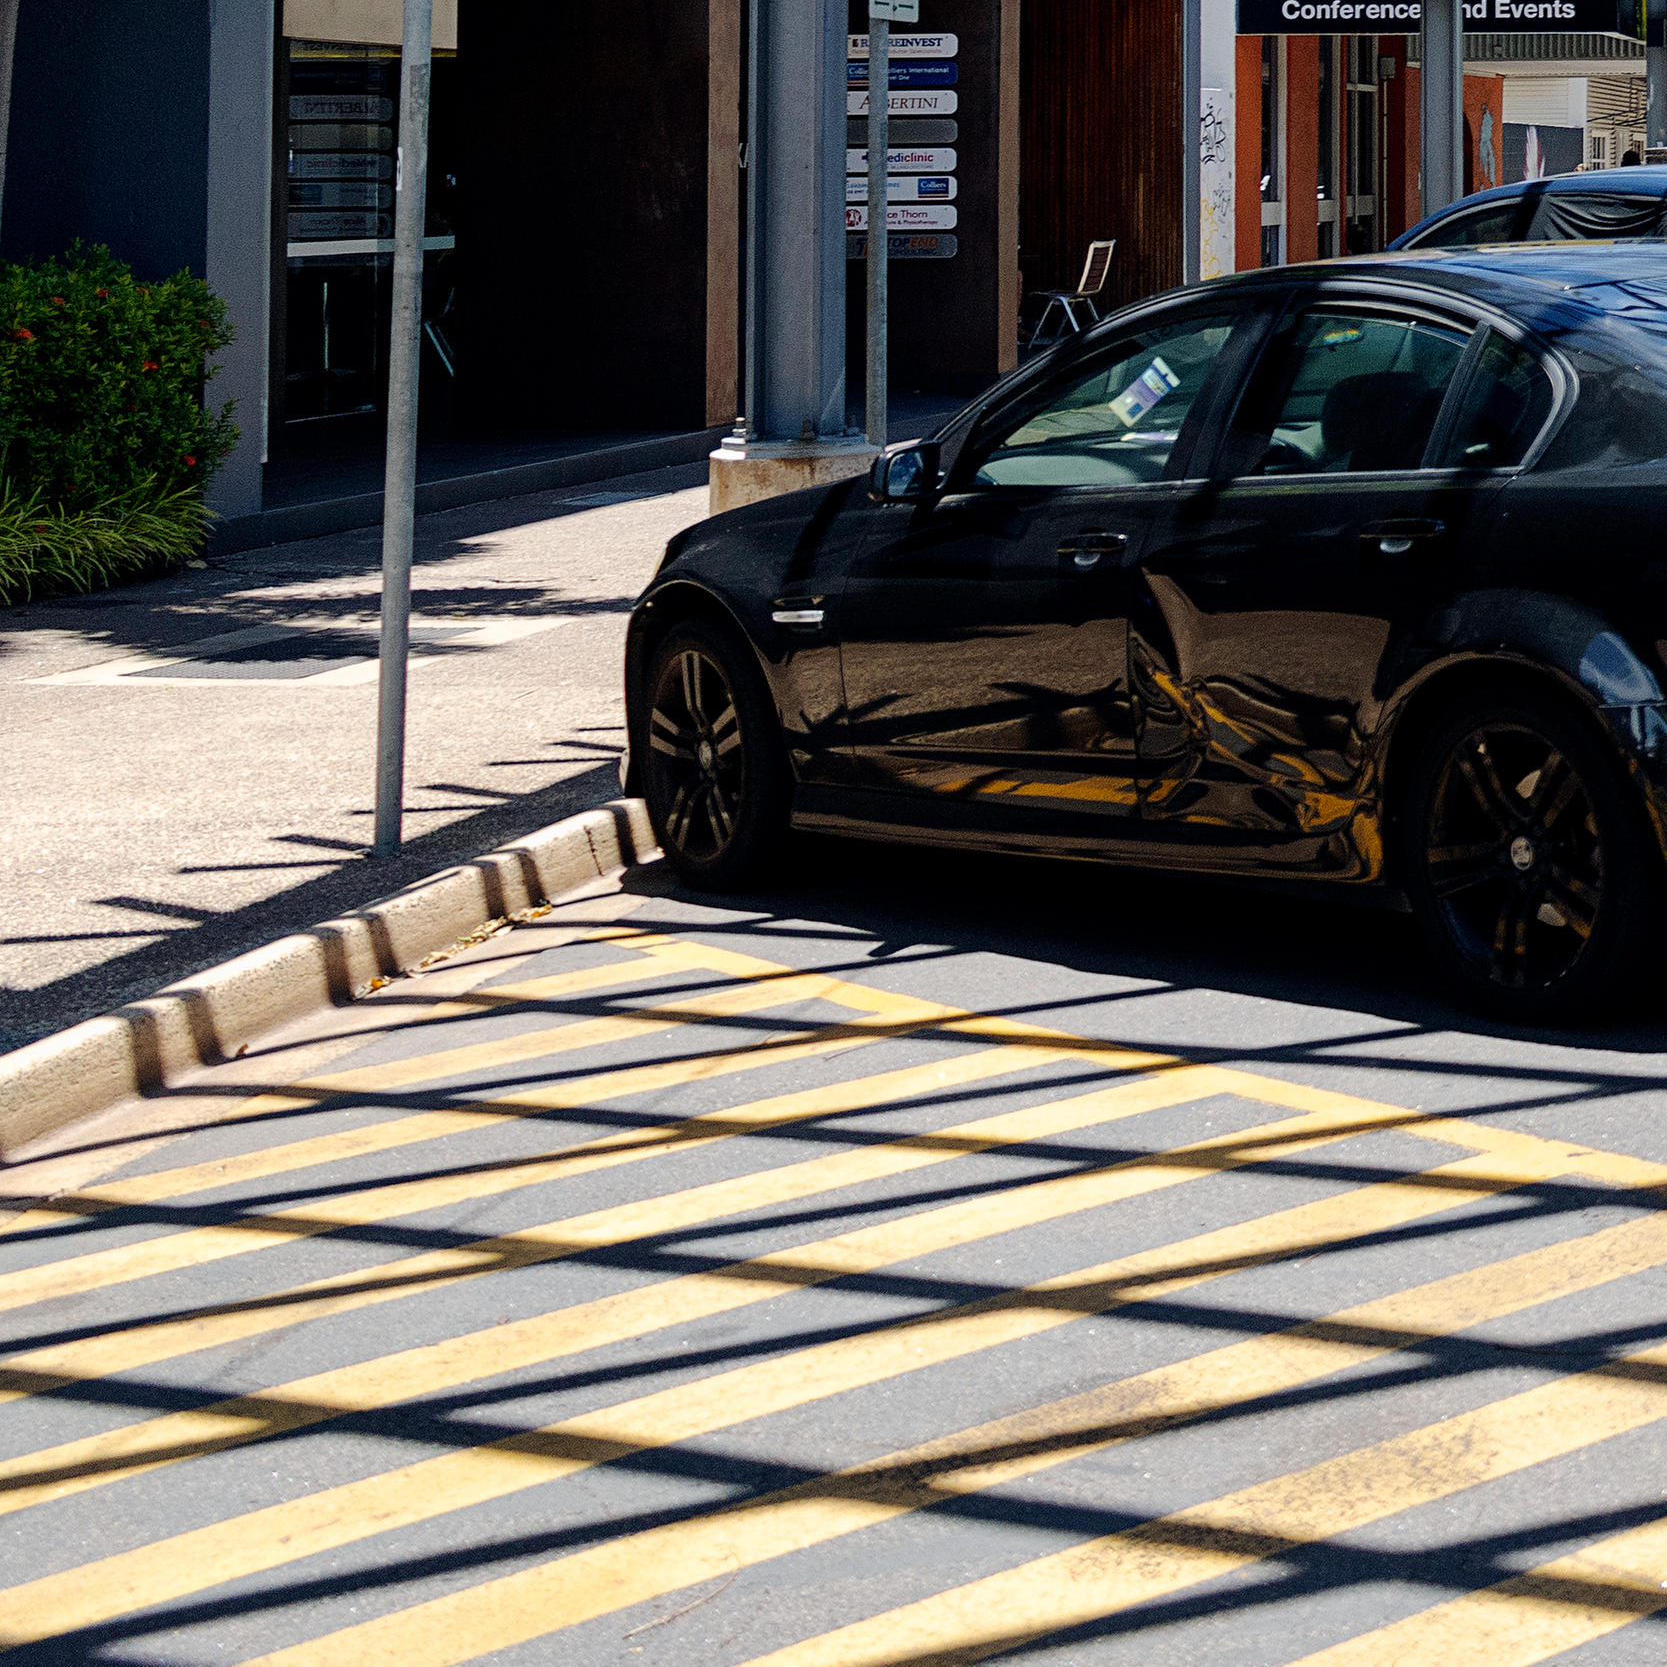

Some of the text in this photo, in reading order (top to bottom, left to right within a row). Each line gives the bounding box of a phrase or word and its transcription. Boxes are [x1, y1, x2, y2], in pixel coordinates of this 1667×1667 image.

[1281, 0, 1422, 20] Conference
[1494, 0, 1576, 19] Events
[908, 65, 950, 74] International
[859, 95, 938, 110] AERTINI
[886, 152, 934, 163] ediclinic
[901, 209, 928, 219] Thorn
